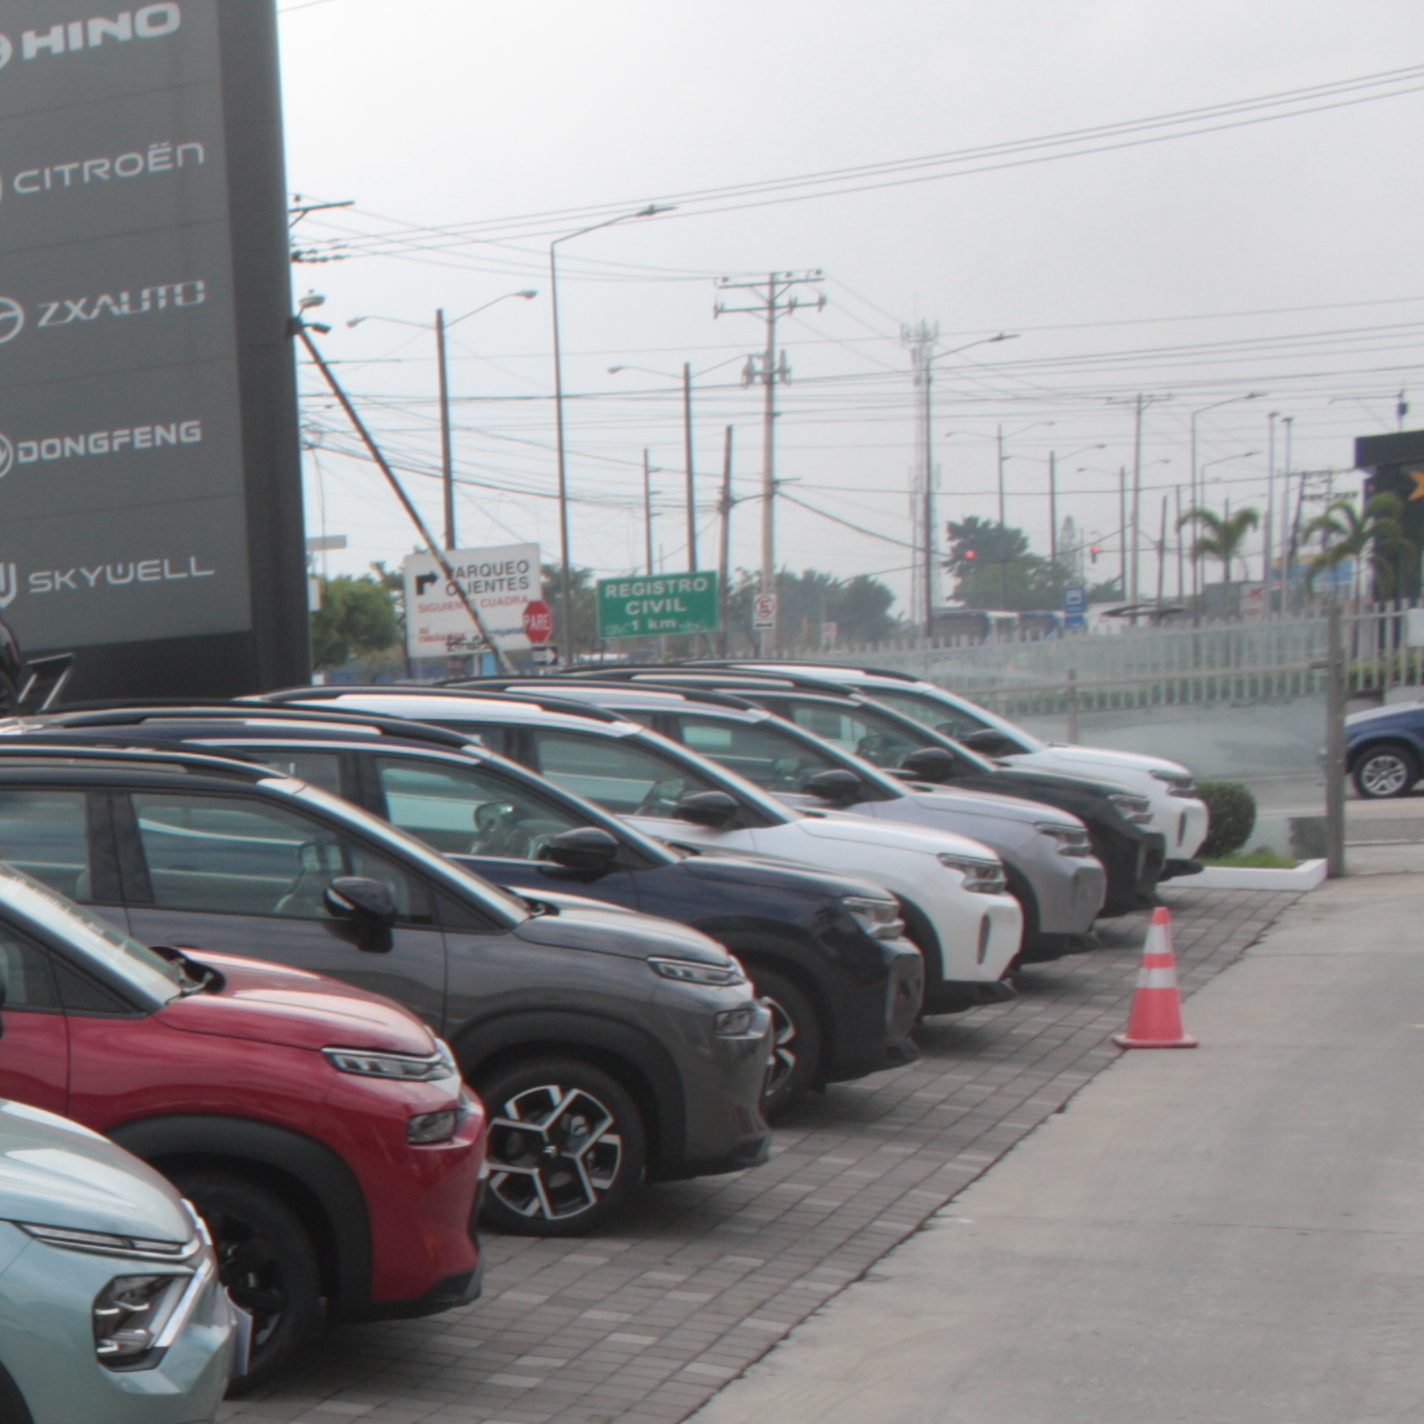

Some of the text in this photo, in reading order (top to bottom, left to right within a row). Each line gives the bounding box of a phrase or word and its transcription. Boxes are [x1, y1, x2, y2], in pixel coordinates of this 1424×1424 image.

[21, 2, 181, 60] HINO
[13, 142, 205, 194] CITROËN
[36, 280, 205, 327] ZXAUTO
[17, 420, 201, 464] DONGFENG
[28, 556, 215, 593] SKYWELL
[450, 560, 529, 578] ARQUEO
[445, 576, 529, 596] CIENTES
[605, 577, 709, 599] REGISTRO
[418, 595, 527, 613] SIGUIEN CUADRA
[625, 598, 688, 615] CIVIL
[524, 614, 551, 630] PARE
[630, 619, 640, 632] 1
[648, 618, 678, 630] km
